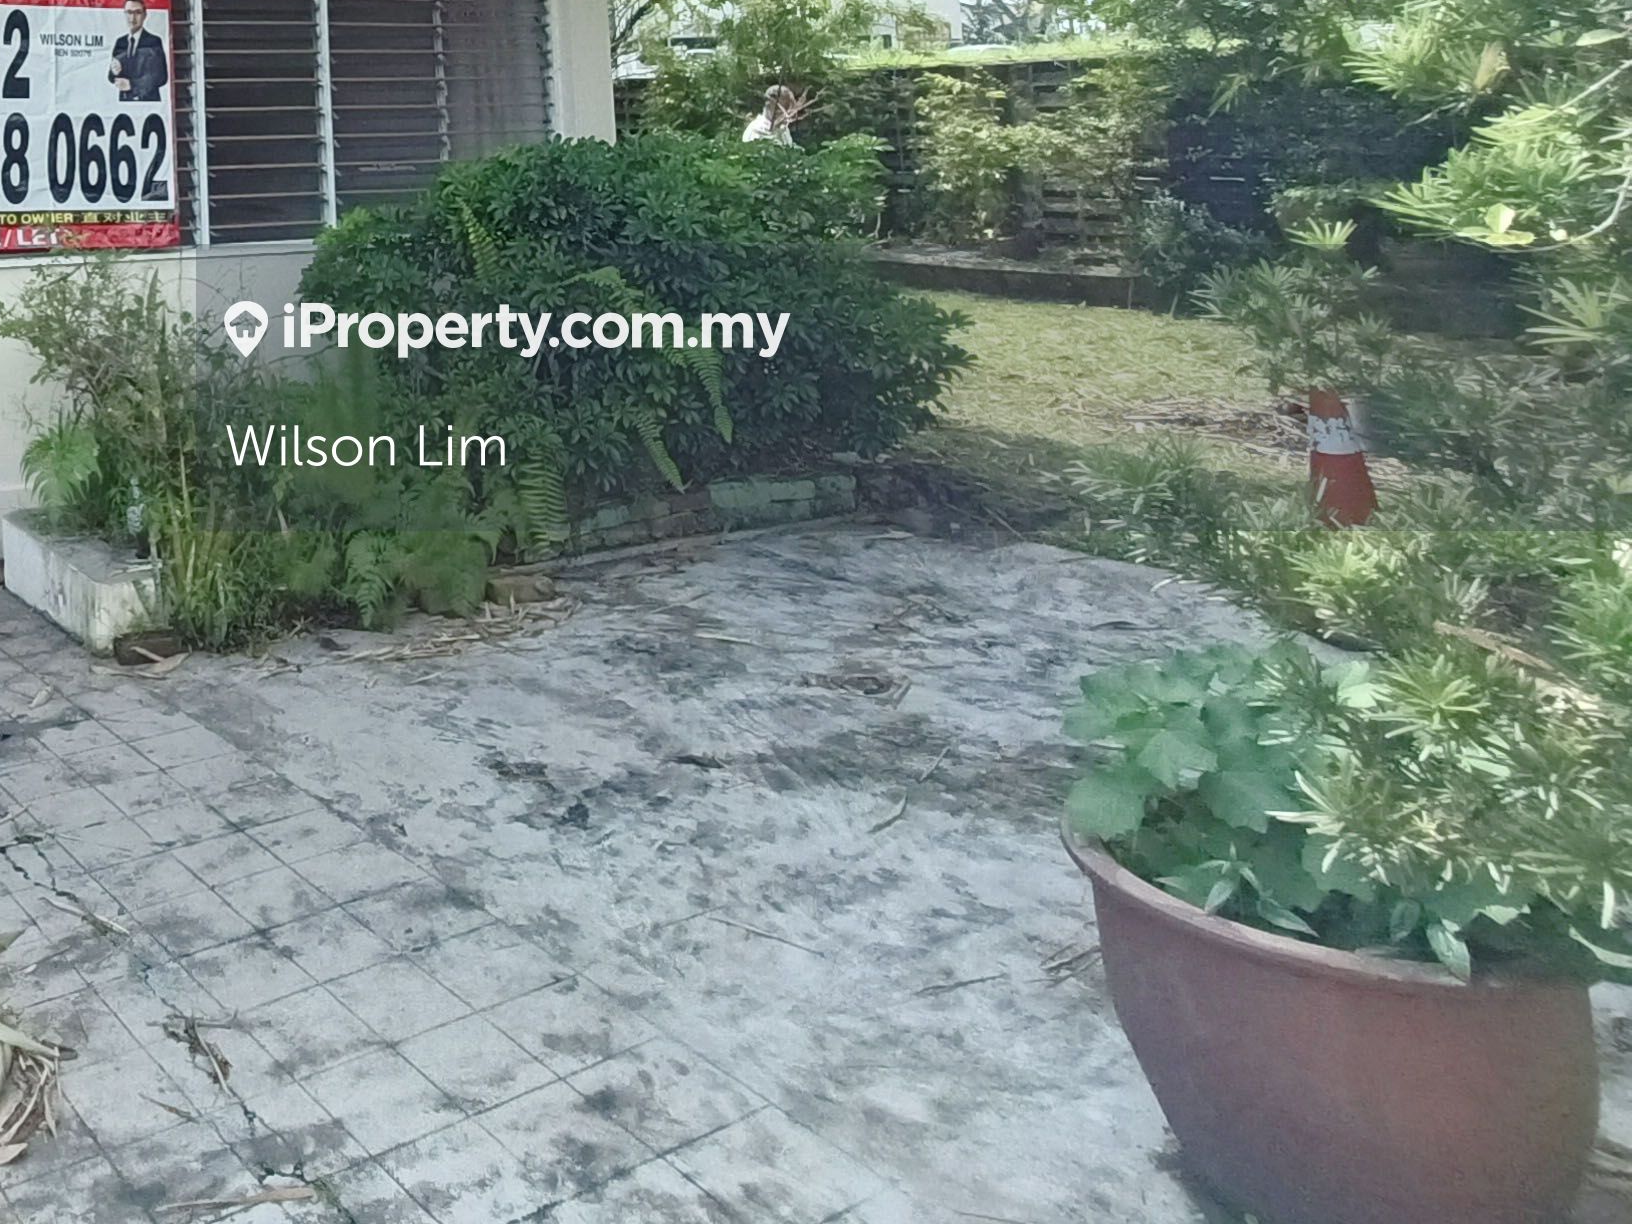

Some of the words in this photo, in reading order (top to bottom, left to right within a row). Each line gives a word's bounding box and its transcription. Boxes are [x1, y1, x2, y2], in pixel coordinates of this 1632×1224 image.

[39, 33, 82, 46] WILSON
[85, 35, 104, 47] LIM
[47, 112, 169, 204] 0662
